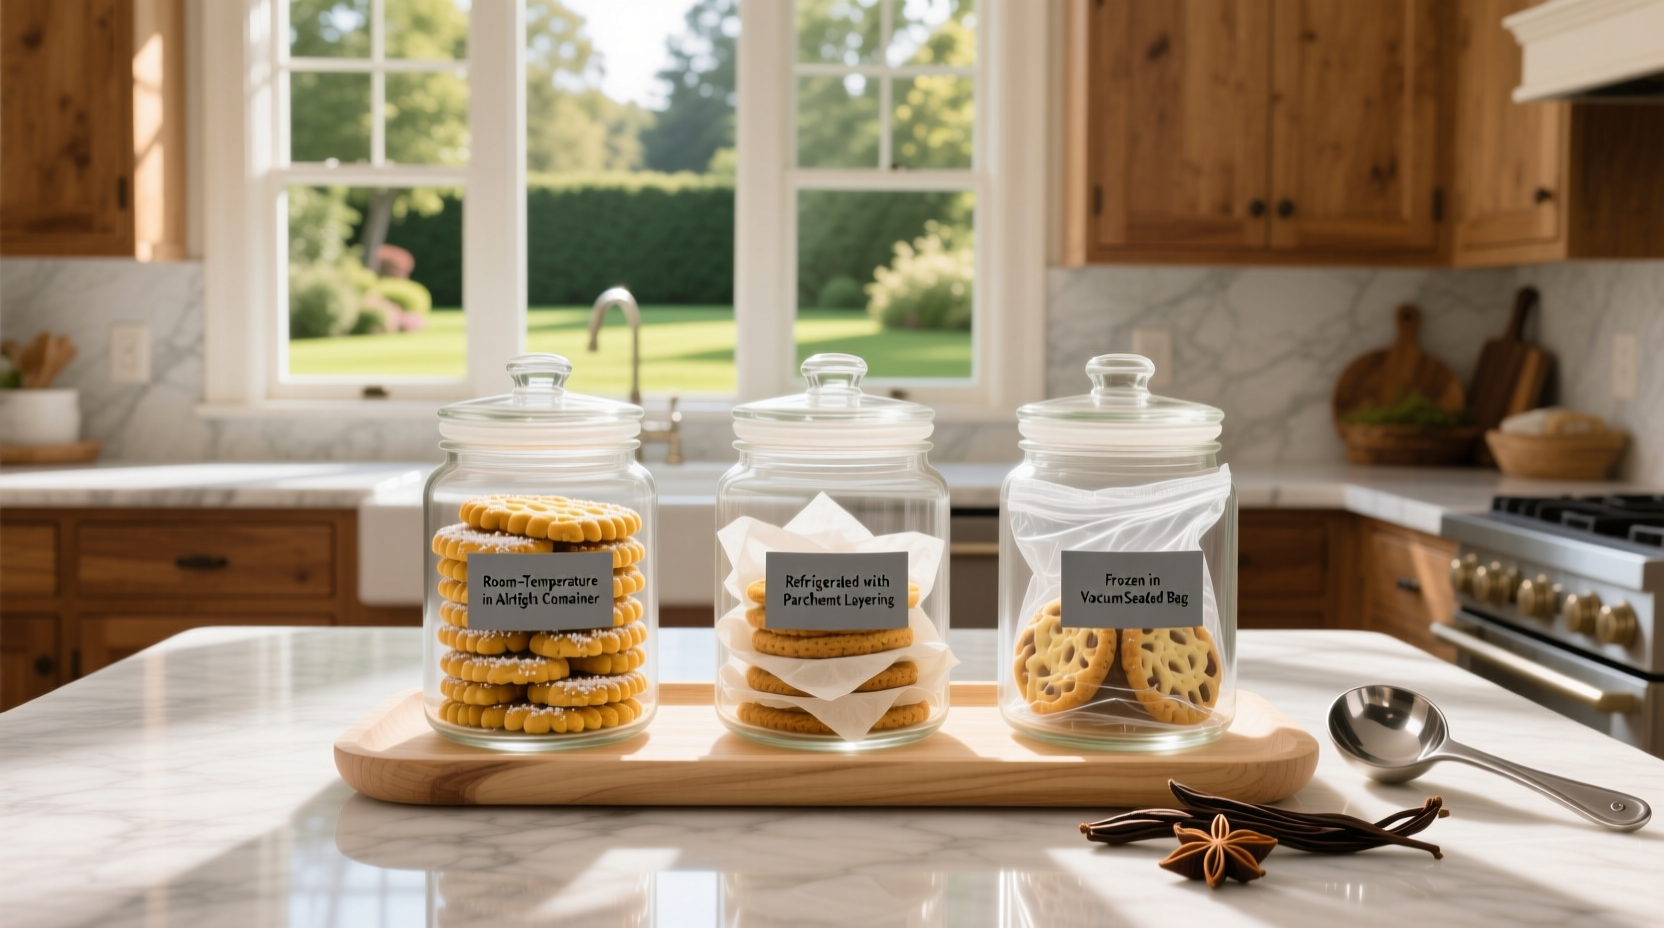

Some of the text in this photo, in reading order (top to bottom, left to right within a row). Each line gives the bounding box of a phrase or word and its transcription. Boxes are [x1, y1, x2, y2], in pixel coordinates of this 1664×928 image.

[863, 574, 890, 588] with
[1105, 572, 1160, 587] Frozen in
[482, 593, 493, 605] in
[1166, 591, 1189, 607] Bag
